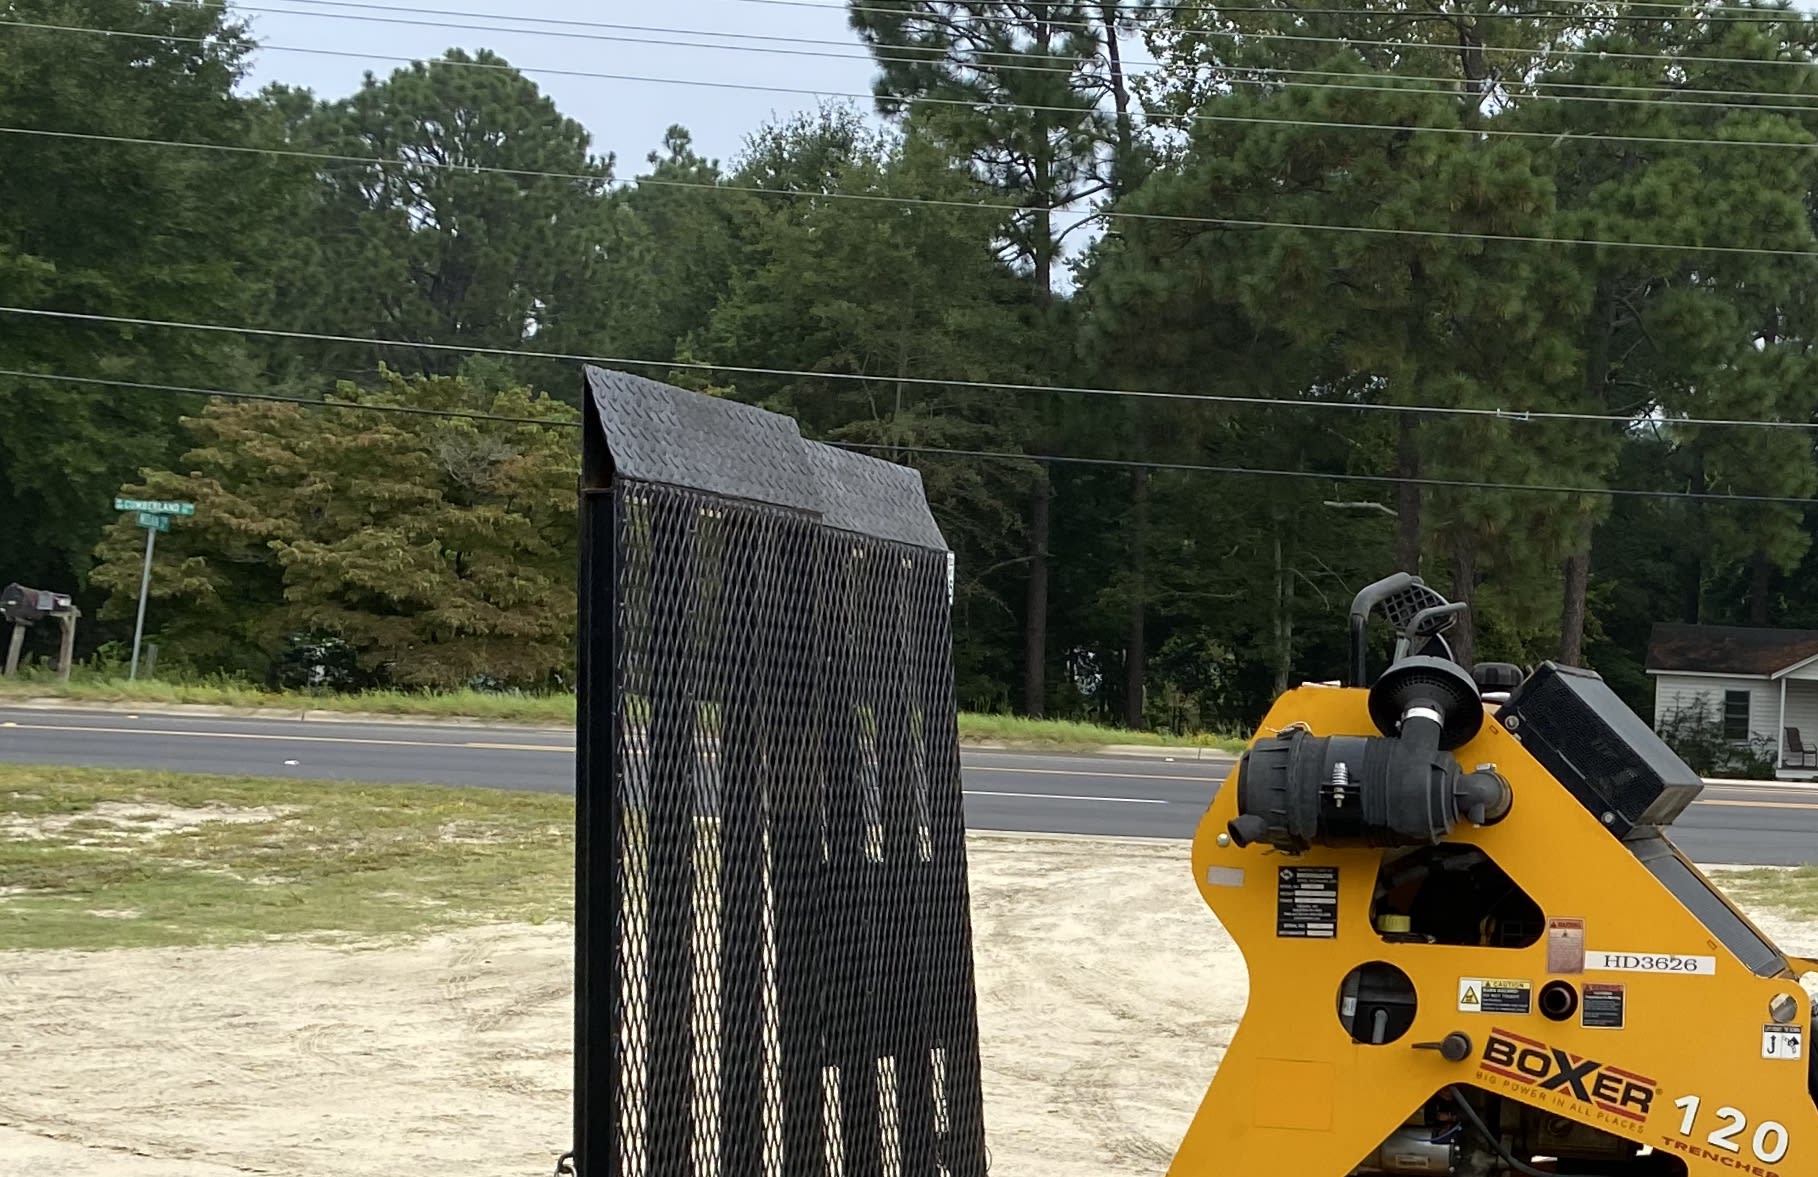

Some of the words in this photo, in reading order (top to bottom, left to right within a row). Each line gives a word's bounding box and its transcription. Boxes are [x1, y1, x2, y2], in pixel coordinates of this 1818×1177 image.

[1604, 955, 1698, 972] HD3626
[1476, 1071, 1497, 1085] BIG
[1503, 1080, 1547, 1101] POWER
[1552, 1097, 1565, 1108] IN
[1571, 1102, 1591, 1117] ALL
[1597, 1111, 1644, 1135] PLACES
[1482, 1035, 1654, 1114] BOXER
[1674, 1094, 1790, 1165] 120
